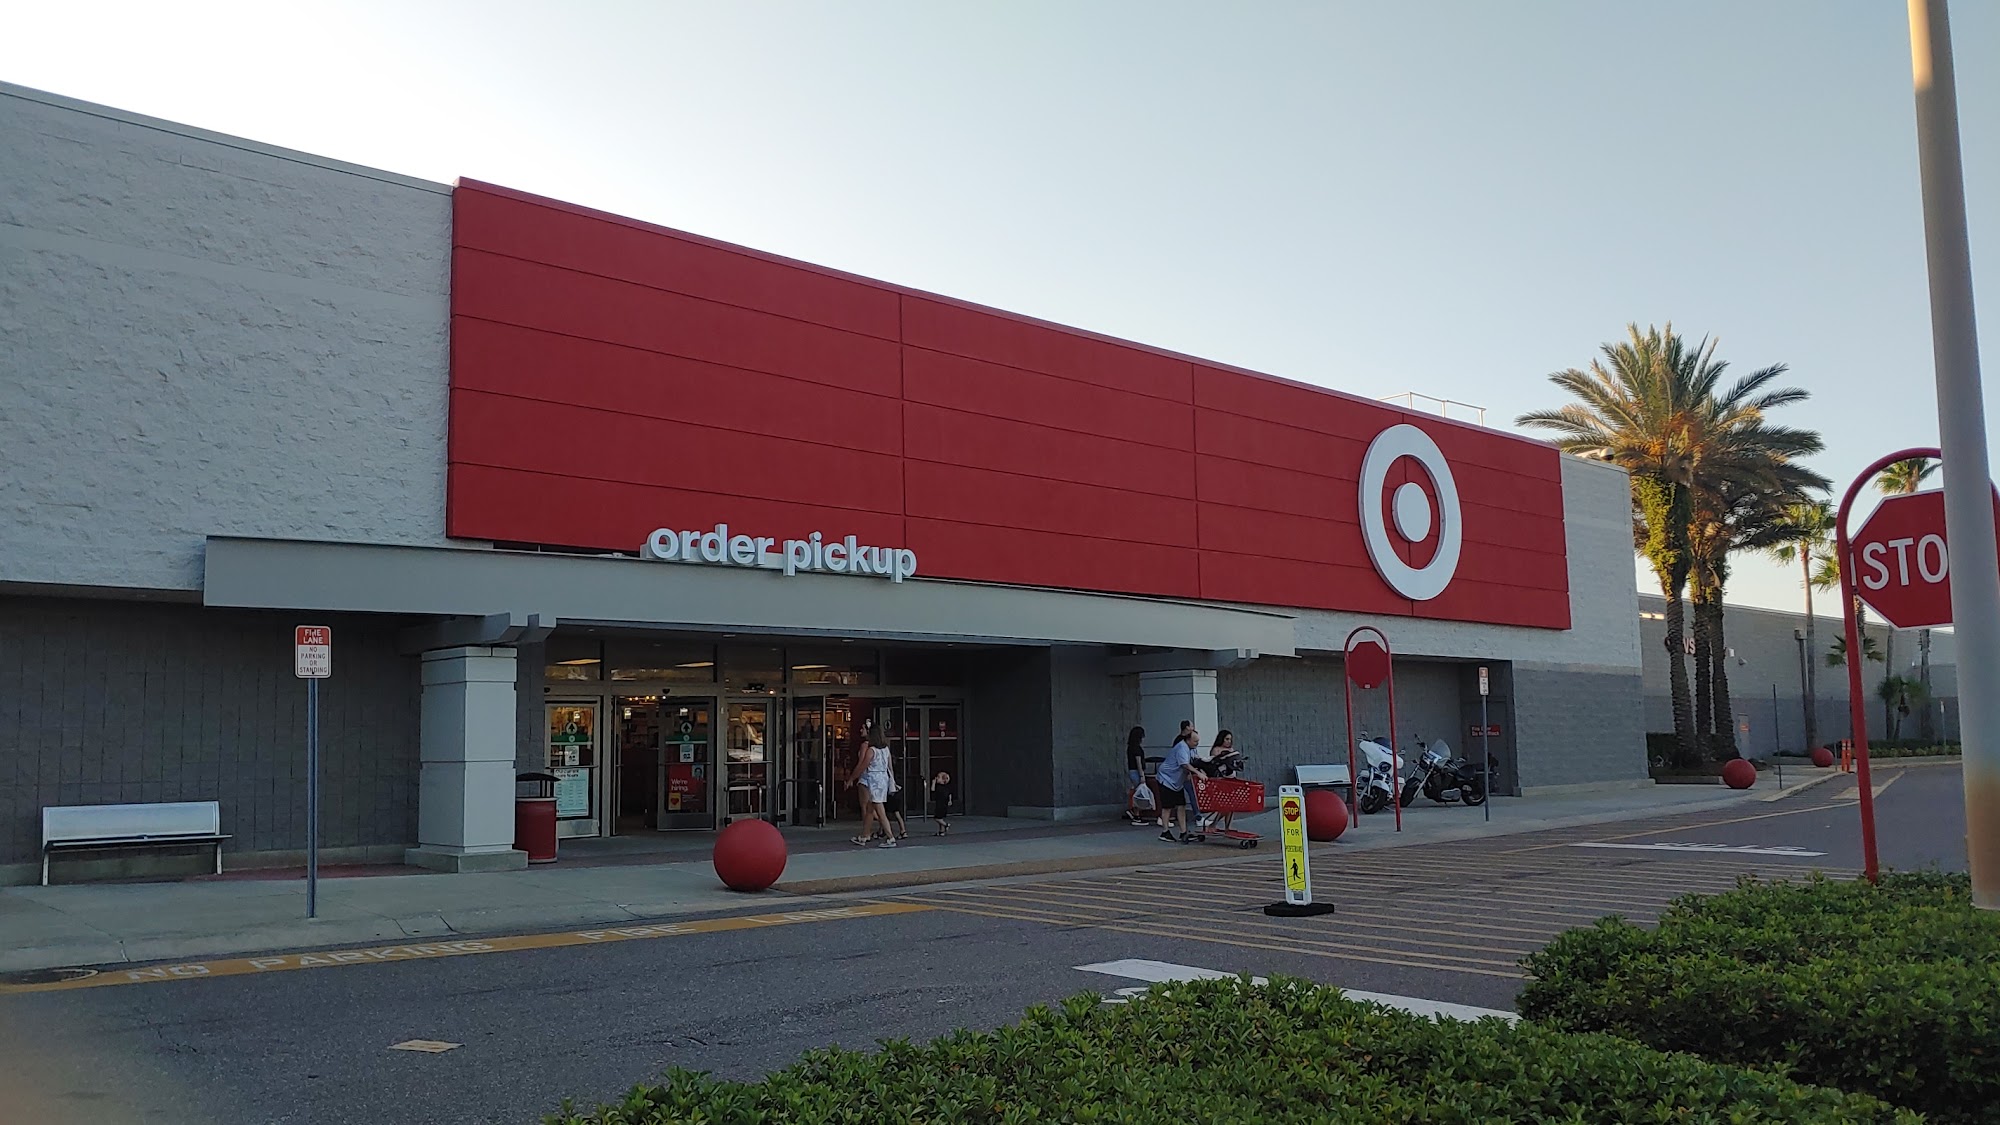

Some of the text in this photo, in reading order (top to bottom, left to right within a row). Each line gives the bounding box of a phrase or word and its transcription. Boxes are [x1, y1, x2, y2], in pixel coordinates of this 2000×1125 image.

[648, 523, 917, 583] order pickup
[1862, 533, 1949, 590] STO
[1284, 807, 1299, 816] STOP
[1286, 828, 1300, 836] FOR
[127, 964, 210, 980] NO
[249, 942, 493, 969] PARKING
[576, 925, 697, 940] FIRE
